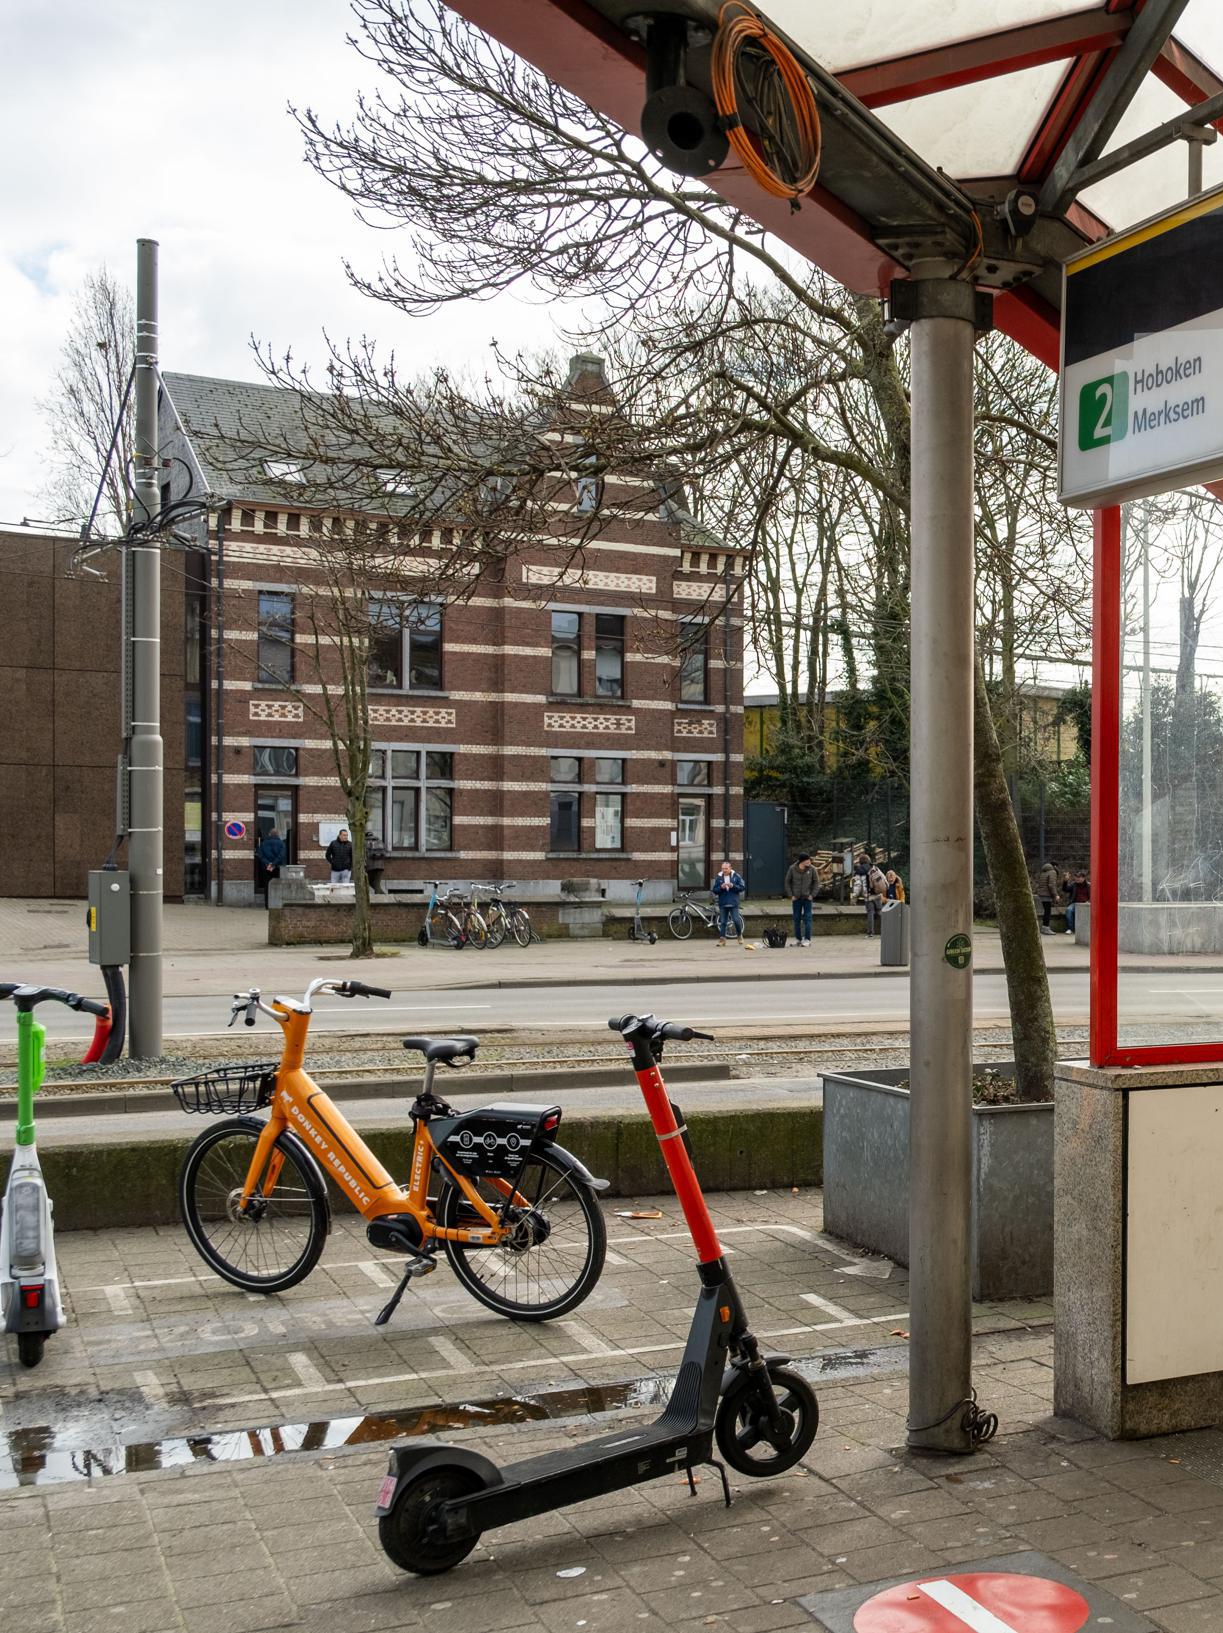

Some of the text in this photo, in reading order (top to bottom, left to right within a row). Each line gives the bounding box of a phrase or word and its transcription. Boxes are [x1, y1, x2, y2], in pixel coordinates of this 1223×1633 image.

[1134, 356, 1201, 395] Hoboken
[1093, 383, 1112, 440] 2
[1133, 396, 1205, 435] Merksem
[290, 1106, 371, 1205] DONKEY REPUBLIC
